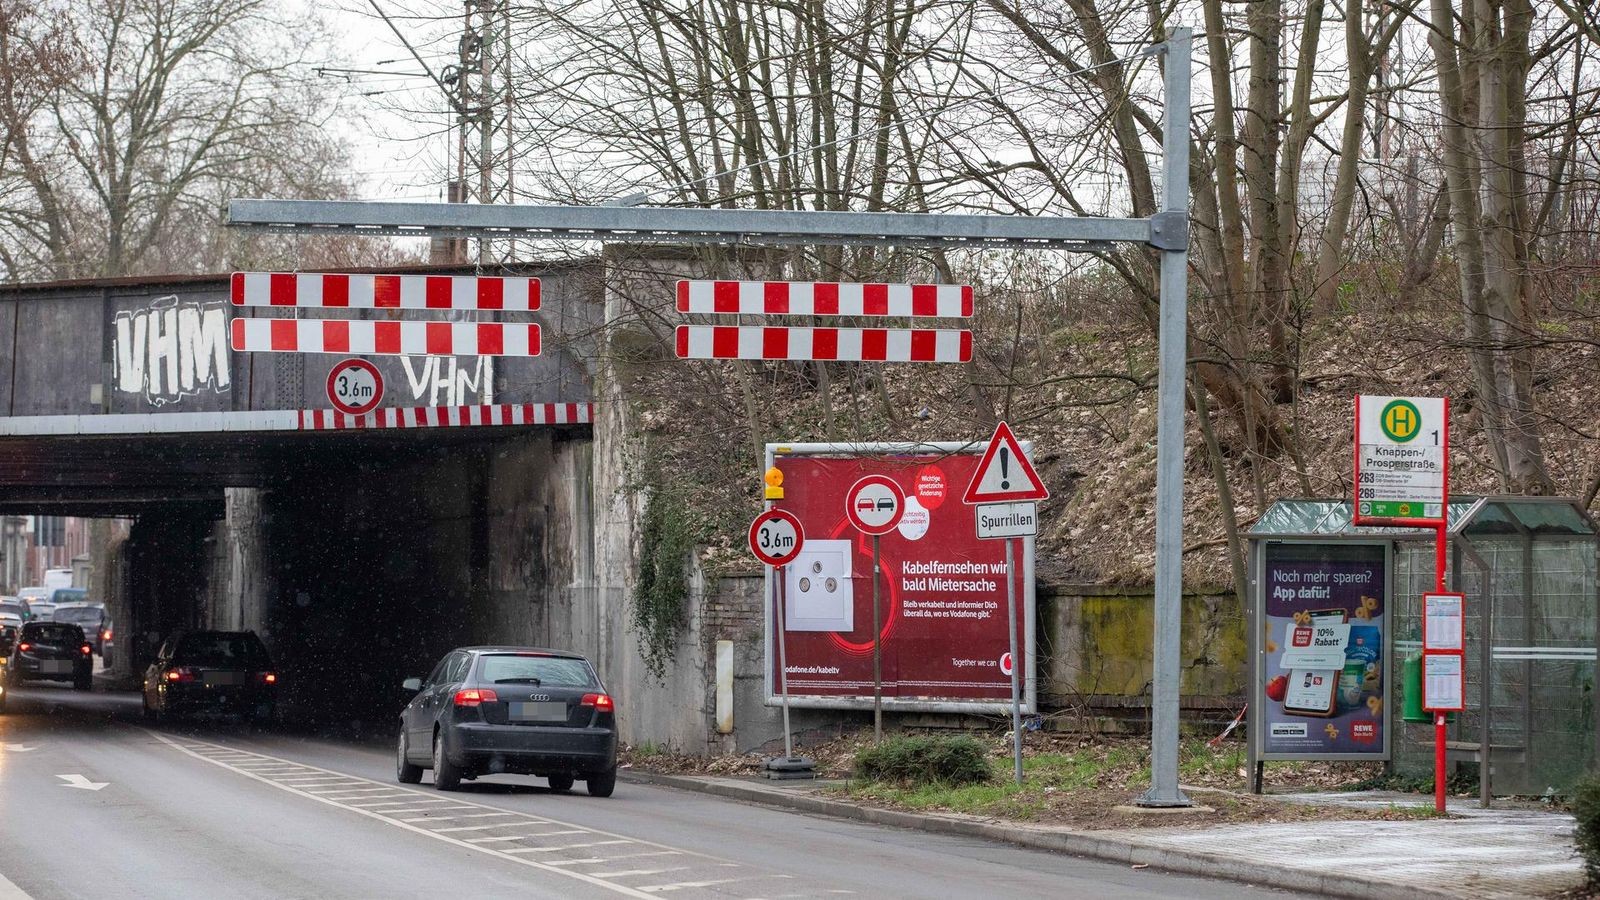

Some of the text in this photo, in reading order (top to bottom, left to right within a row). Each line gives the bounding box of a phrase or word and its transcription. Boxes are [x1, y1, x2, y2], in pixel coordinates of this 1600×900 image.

[114, 304, 231, 396] VHM
[400, 353, 492, 406] VHM
[1431, 430, 1439, 446] 1
[1375, 447, 1426, 458] Knappen-/
[1366, 458, 1435, 469] Prosperstraße
[1359, 472, 1375, 483] 263
[1359, 488, 1375, 498] 268
[981, 513, 1033, 531] Spurrillen
[902, 560, 1015, 575] Kabelfernsehen wir
[1273, 569, 1373, 586] Noch mehr sparen?
[902, 577, 997, 592] bald Mietersache
[1273, 586, 1331, 601] App dafür!
[903, 600, 998, 609] Bleib verkabelt und informier Dich
[903, 609, 923, 618] überall
[924, 610, 933, 618] da,
[950, 610, 978, 618] Vodafone
[1317, 627, 1335, 637] 10%
[951, 658, 977, 668] Together
[784, 665, 840, 674] odafone.de/kabeltv
[1353, 724, 1374, 732] REWE
